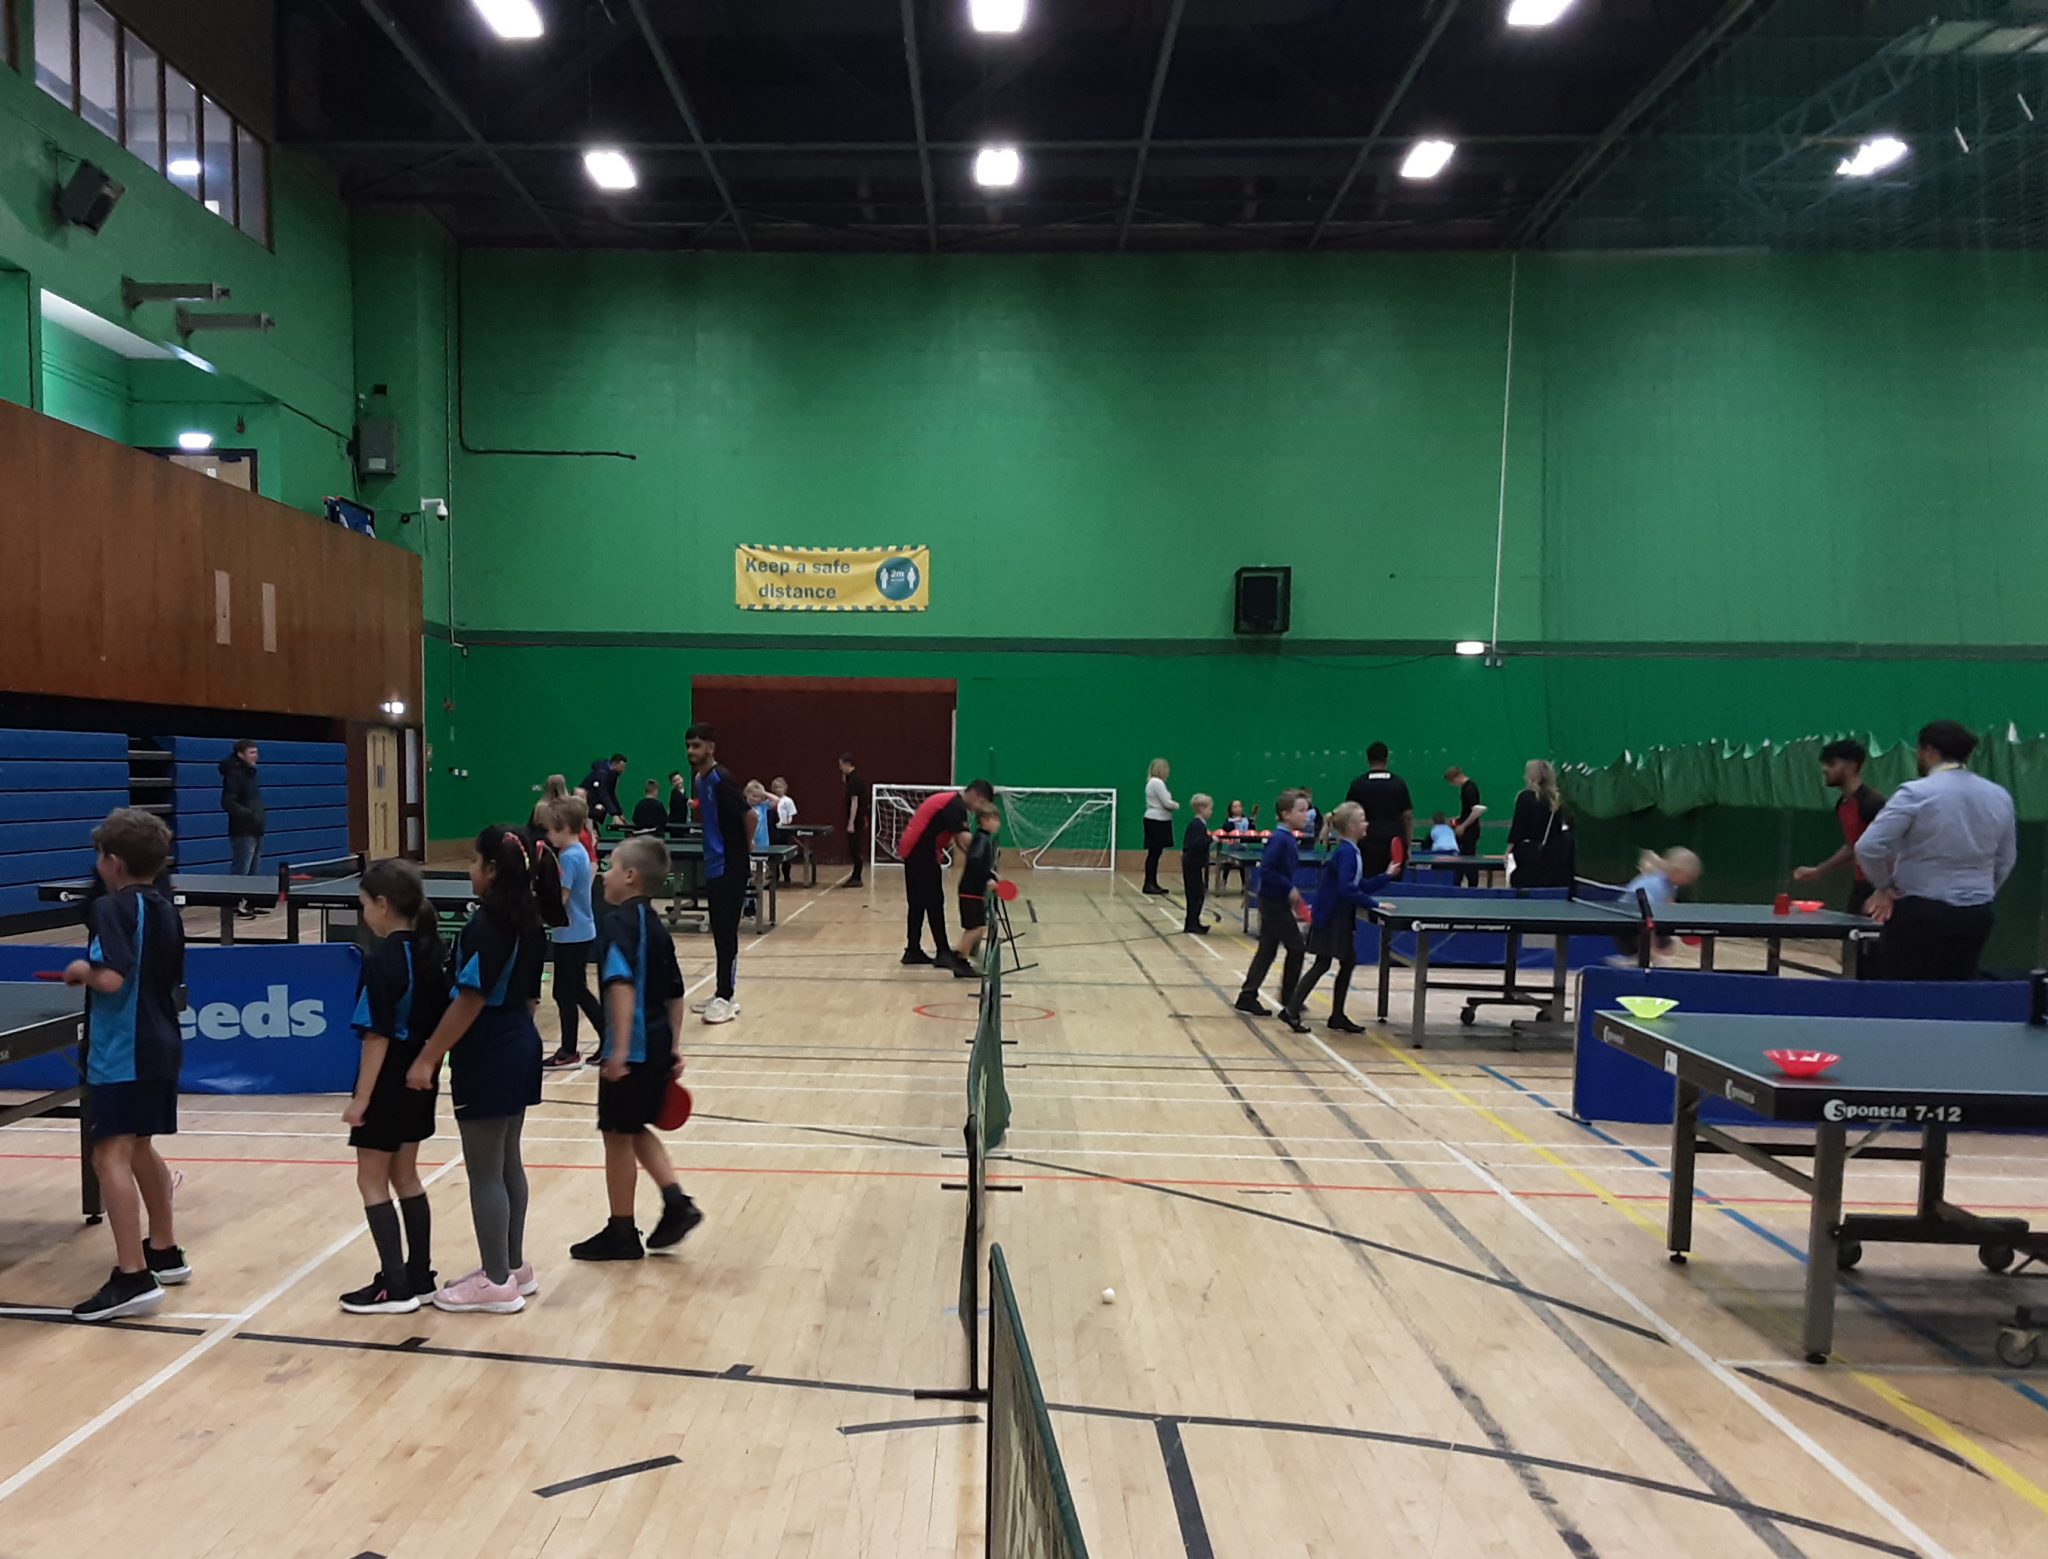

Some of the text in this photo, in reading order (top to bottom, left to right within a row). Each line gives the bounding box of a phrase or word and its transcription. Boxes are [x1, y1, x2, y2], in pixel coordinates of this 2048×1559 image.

[745, 558, 850, 577] Keep a safe
[890, 569, 905, 578] 2m
[758, 583, 837, 600] distance
[1914, 1105, 1963, 1123] 7-12
